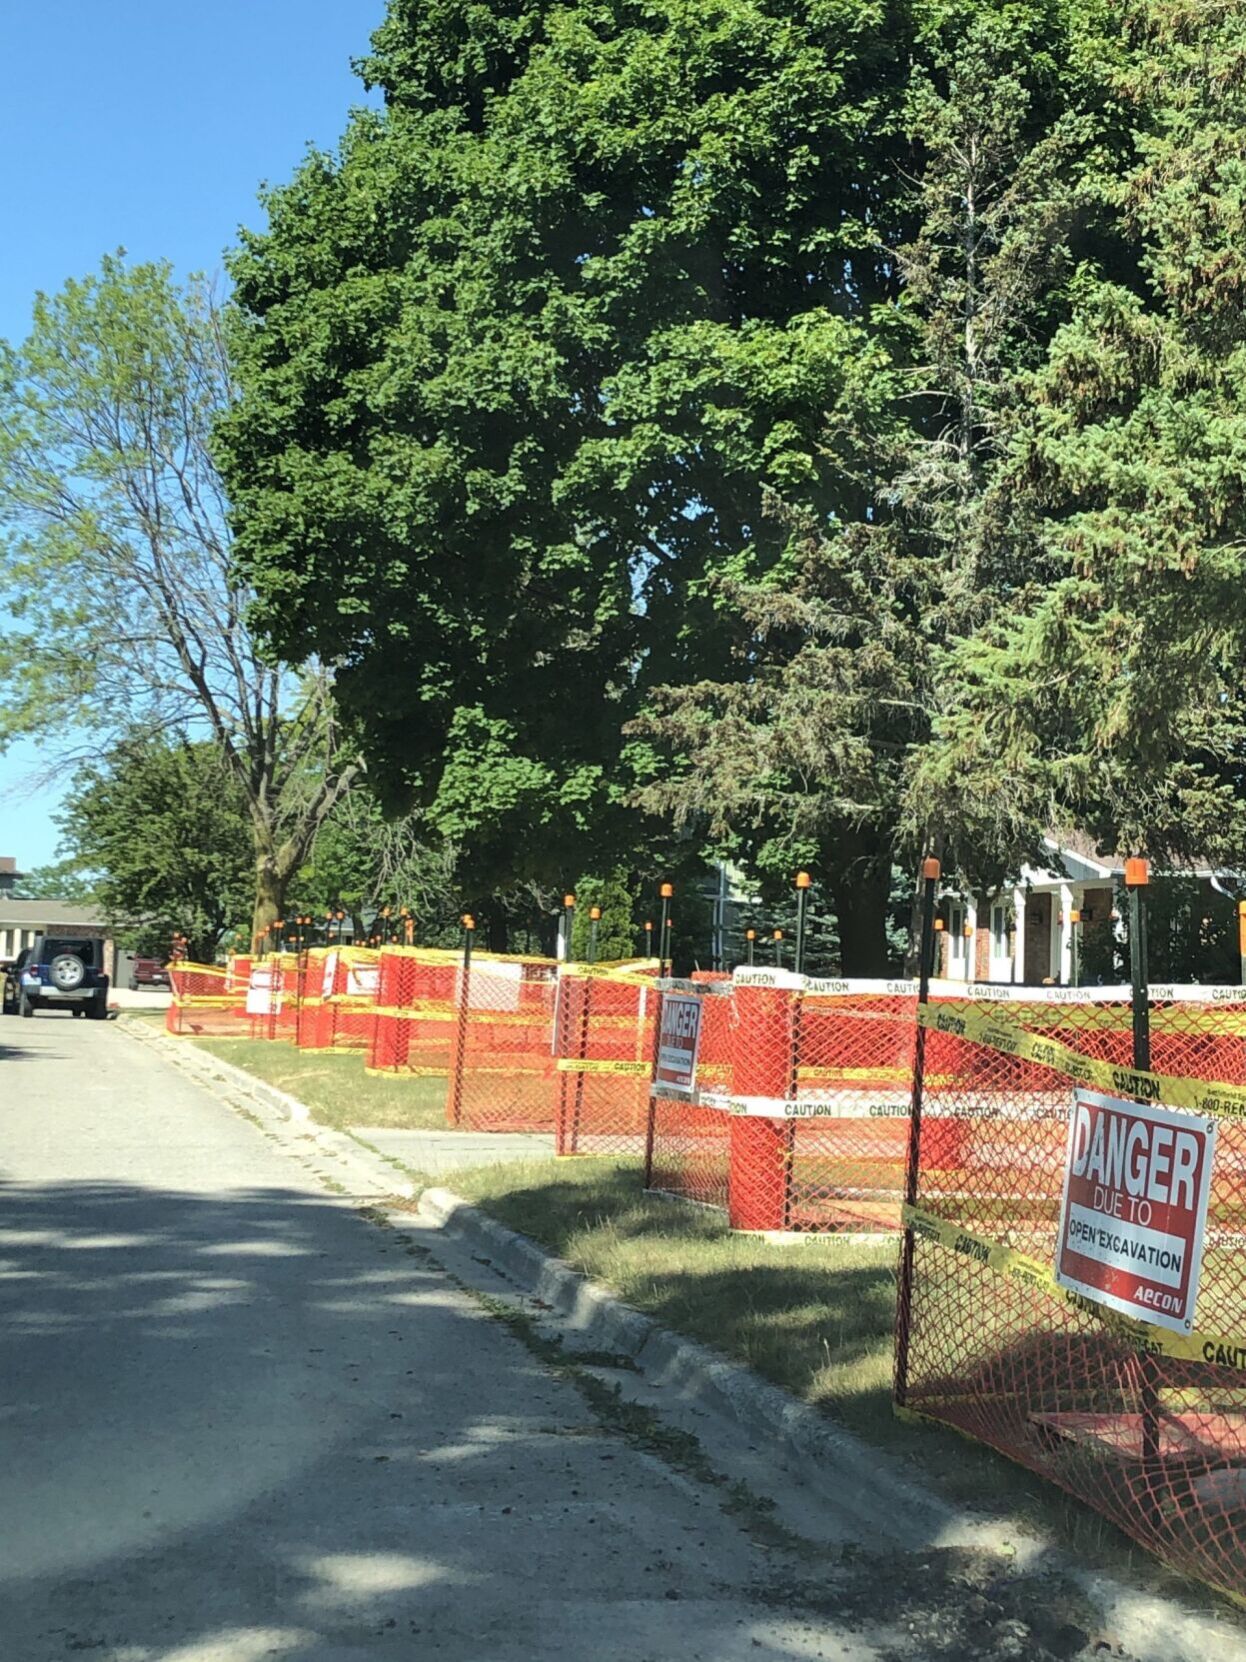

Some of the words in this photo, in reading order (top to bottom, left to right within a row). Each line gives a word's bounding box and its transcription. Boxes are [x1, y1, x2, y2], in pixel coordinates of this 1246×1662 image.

[735, 973, 776, 985] CAUTION
[807, 981, 850, 993] CAUTION
[967, 985, 1010, 998] CAUTION
[1046, 989, 1091, 1000] CAUTION
[1112, 1070, 1161, 1101] CAUTION
[784, 1103, 832, 1117] CAUTION
[1072, 1105, 1199, 1211] DANGER
[1093, 1186, 1124, 1218] DUE
[1127, 1196, 1152, 1226] TO
[1099, 1230, 1182, 1273] EXCAVATION
